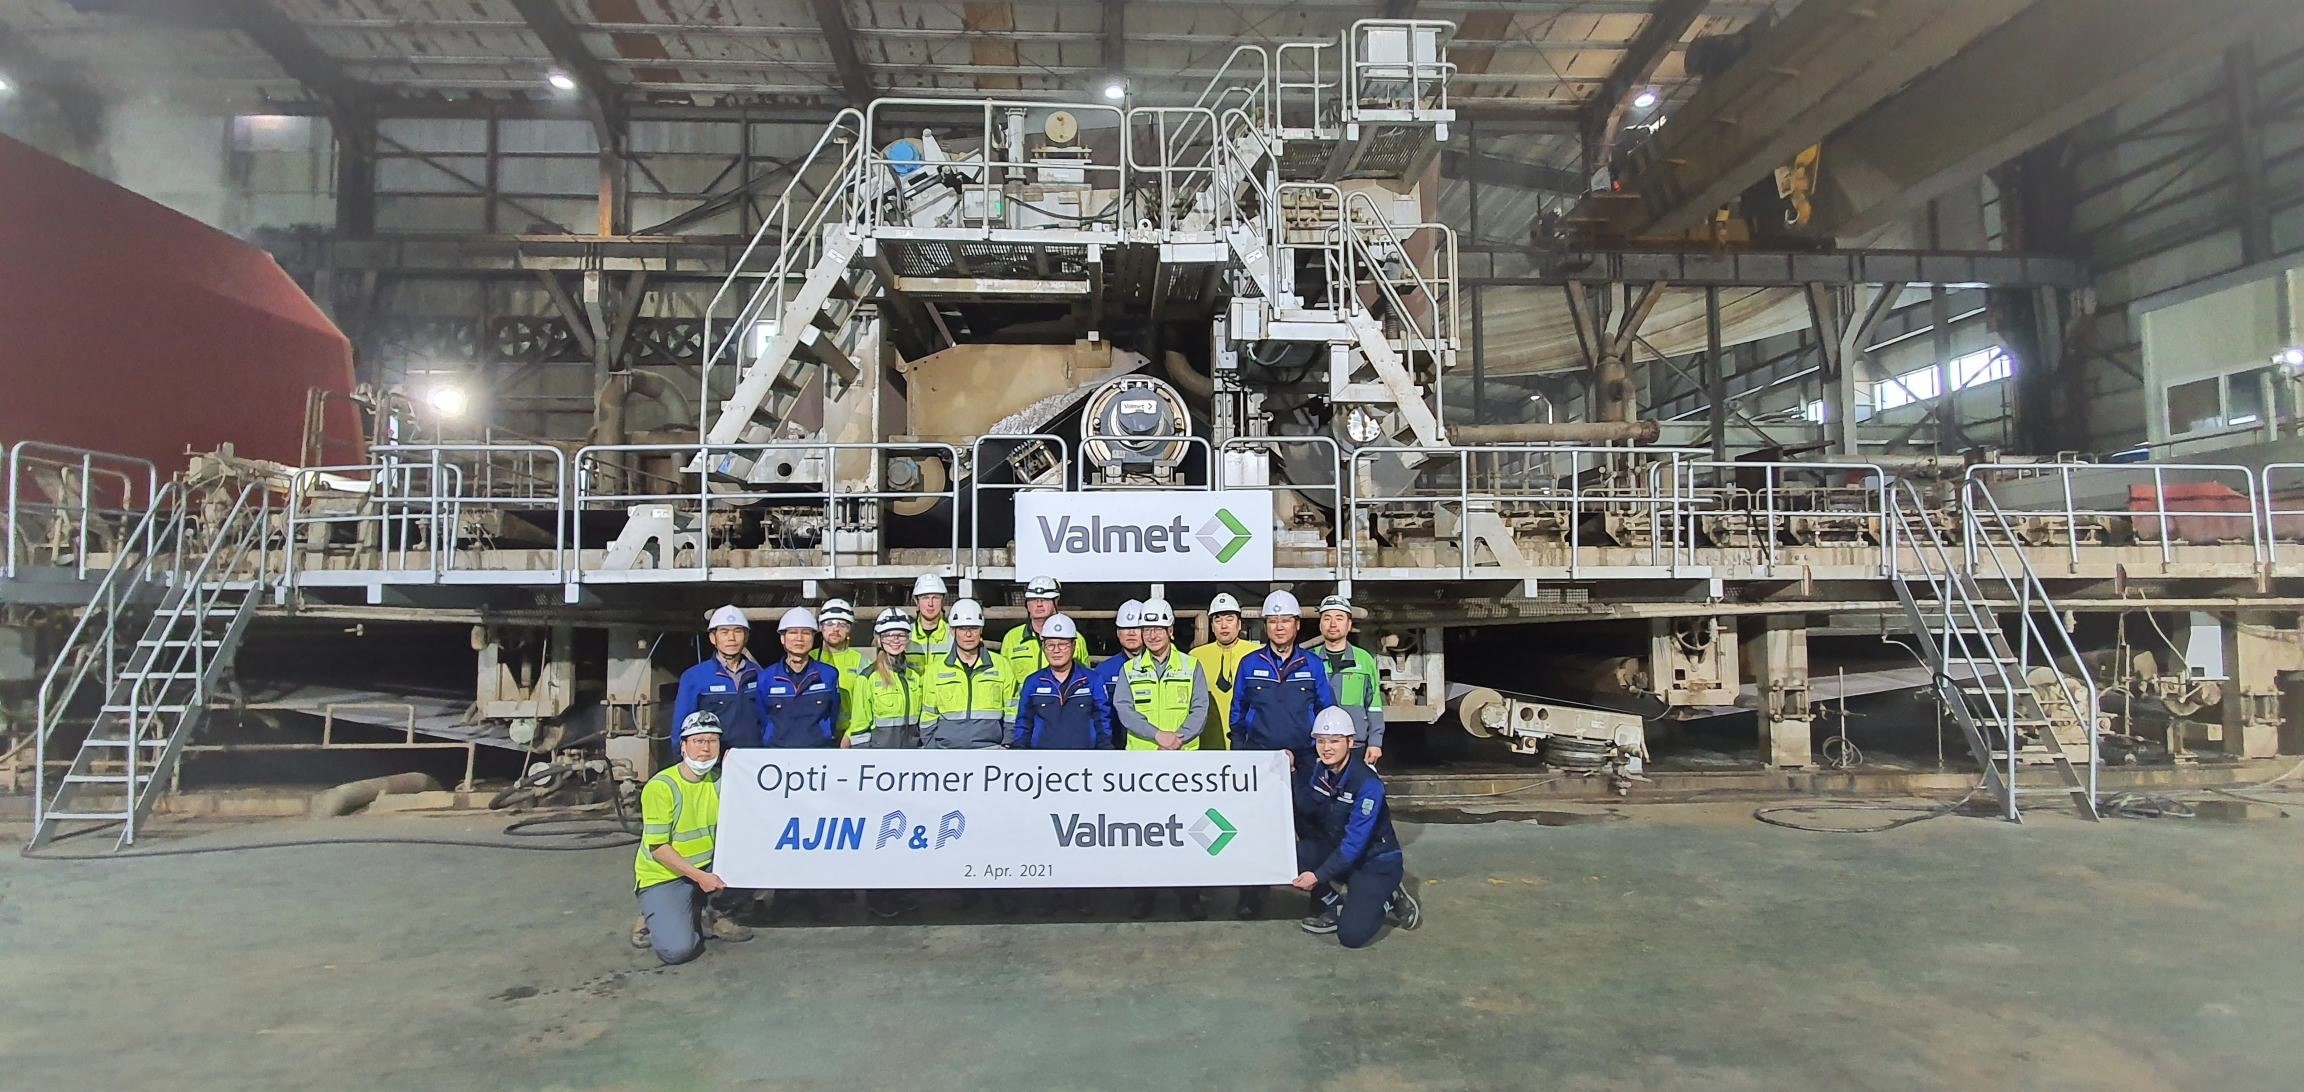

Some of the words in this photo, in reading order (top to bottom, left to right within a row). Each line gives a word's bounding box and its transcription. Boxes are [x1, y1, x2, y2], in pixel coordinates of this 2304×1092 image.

[1037, 515, 1190, 553] Valmet
[757, 764, 827, 798] Opti
[859, 765, 974, 791] Former
[984, 766, 1093, 799] Project
[1103, 765, 1258, 792] successful
[775, 817, 866, 850] AJIN
[1050, 814, 1184, 847] Valmet
[964, 865, 976, 877] 2.
[984, 865, 1011, 880] Apr.
[1020, 865, 1053, 877] 2021
